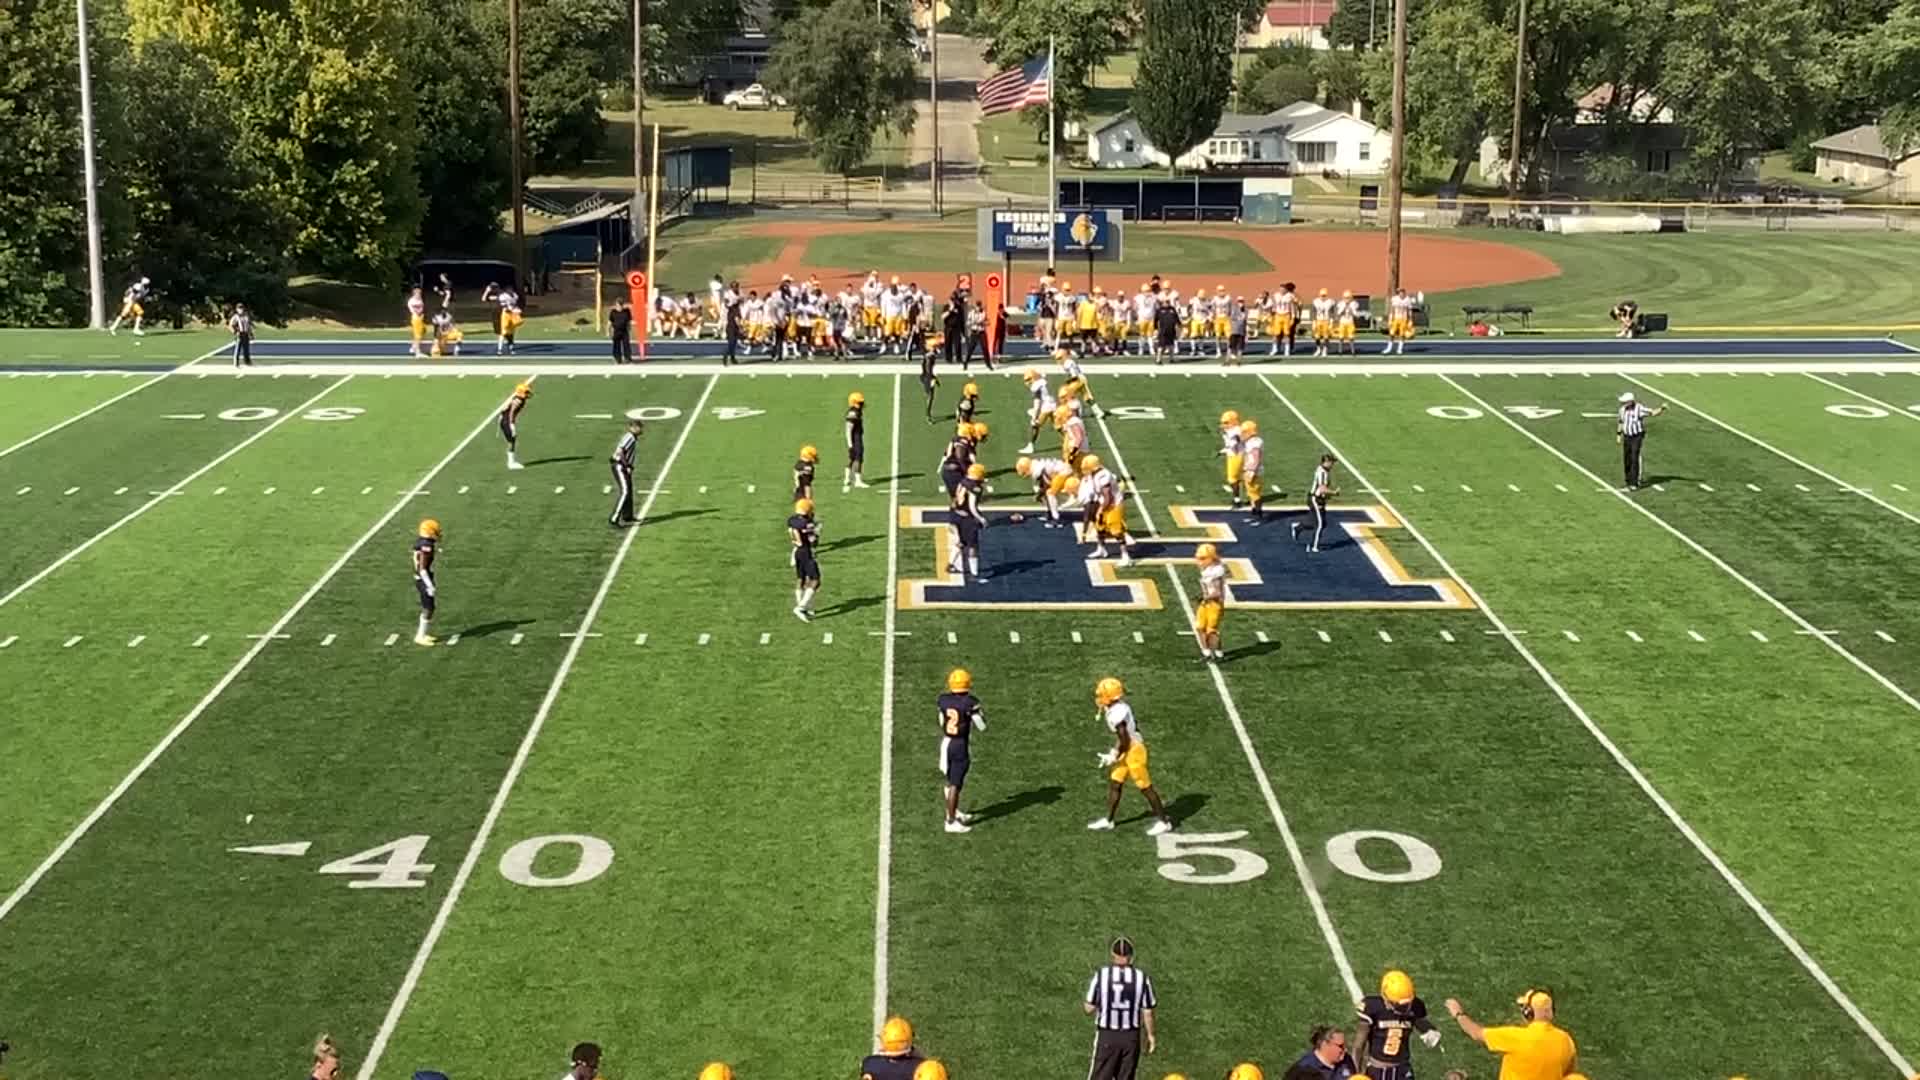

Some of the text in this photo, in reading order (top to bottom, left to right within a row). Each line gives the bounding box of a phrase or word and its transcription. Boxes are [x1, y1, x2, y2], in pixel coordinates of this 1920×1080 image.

[960, 275, 970, 289] 2
[946, 708, 959, 735] 2
[1111, 983, 1130, 1009] L
